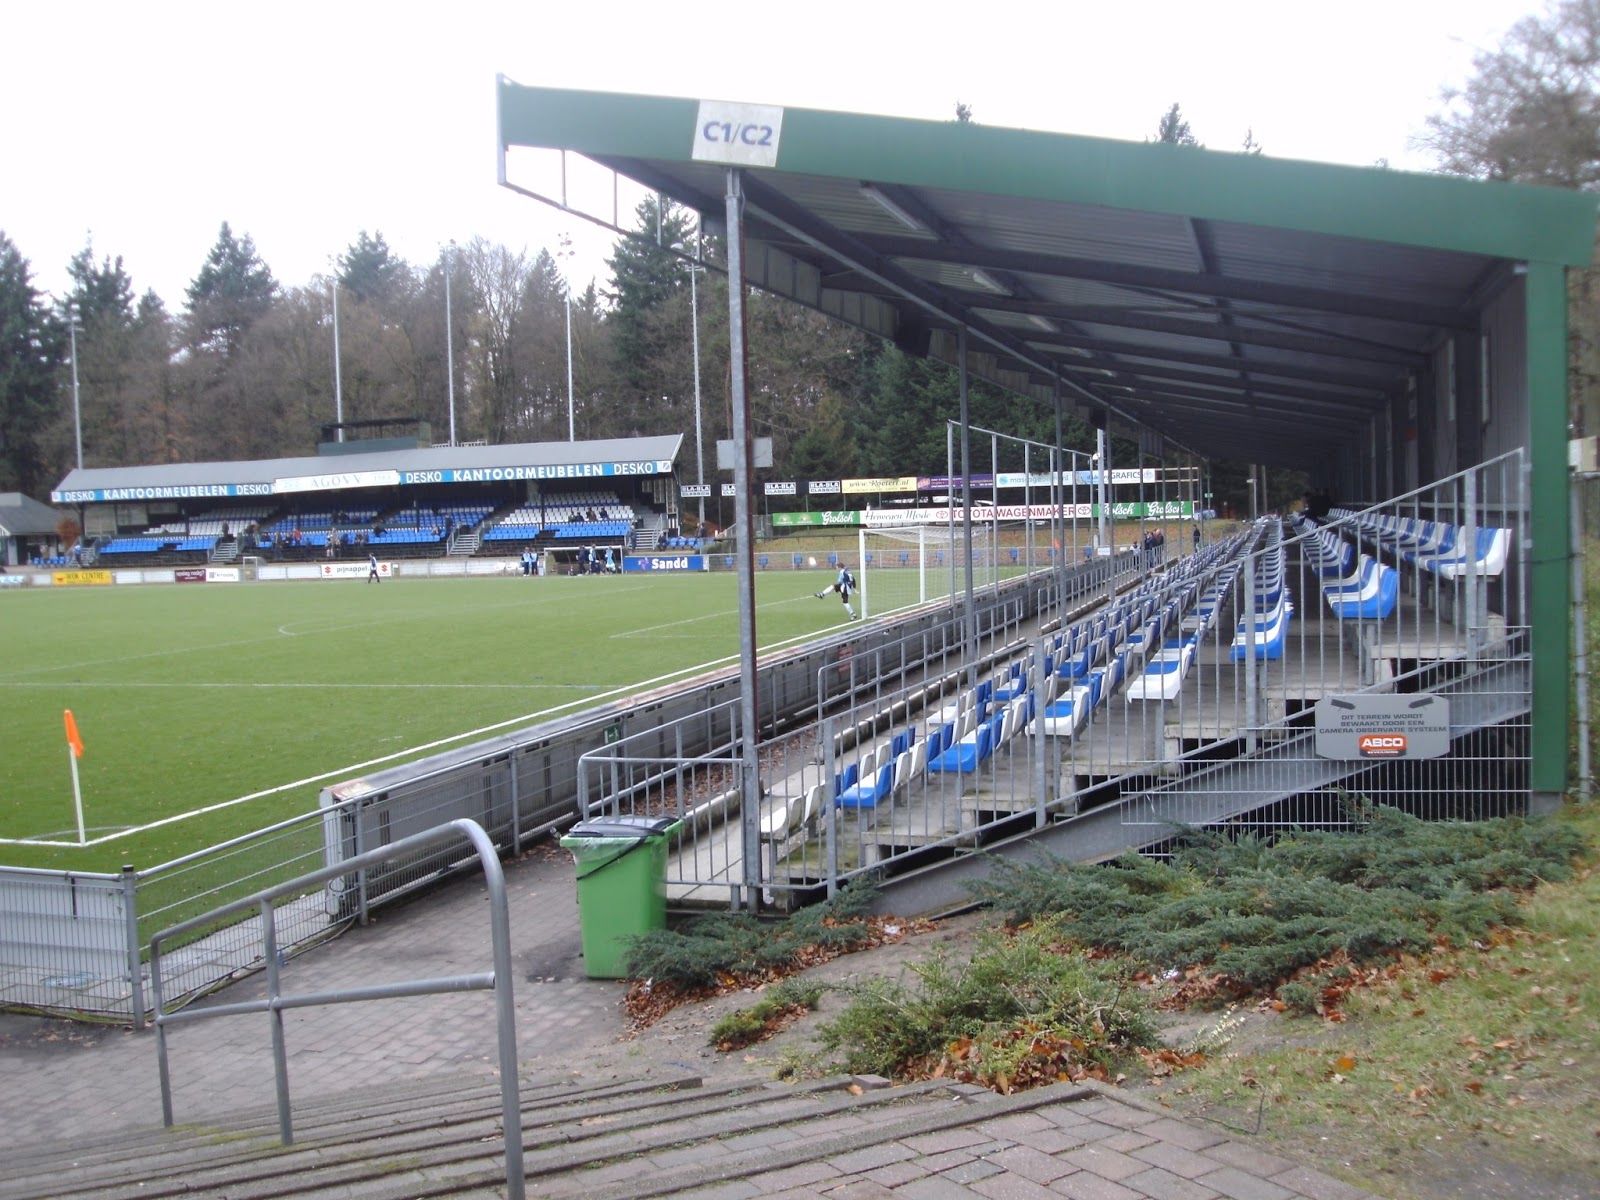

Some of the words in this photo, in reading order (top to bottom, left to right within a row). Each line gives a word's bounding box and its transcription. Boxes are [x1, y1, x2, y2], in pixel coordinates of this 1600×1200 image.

[703, 121, 773, 146] C1/C2
[406, 471, 442, 483] DESKO
[453, 464, 603, 482] KANTOORMEUBELEN
[614, 461, 653, 475] DESKO
[311, 474, 362, 489] AGOVV
[65, 491, 95, 501] DESKO
[103, 485, 228, 500] KANTOORMEUBELEN
[236, 484, 270, 496] DESKO
[822, 511, 854, 525] Grolsch
[906, 509, 930, 520] Mode
[953, 508, 994, 518] TOOTA
[996, 506, 1074, 518] WAGENMAKER
[651, 557, 688, 569] Sandd
[82, 572, 104, 580] CENTRE
[1362, 738, 1403, 747] ABCO
